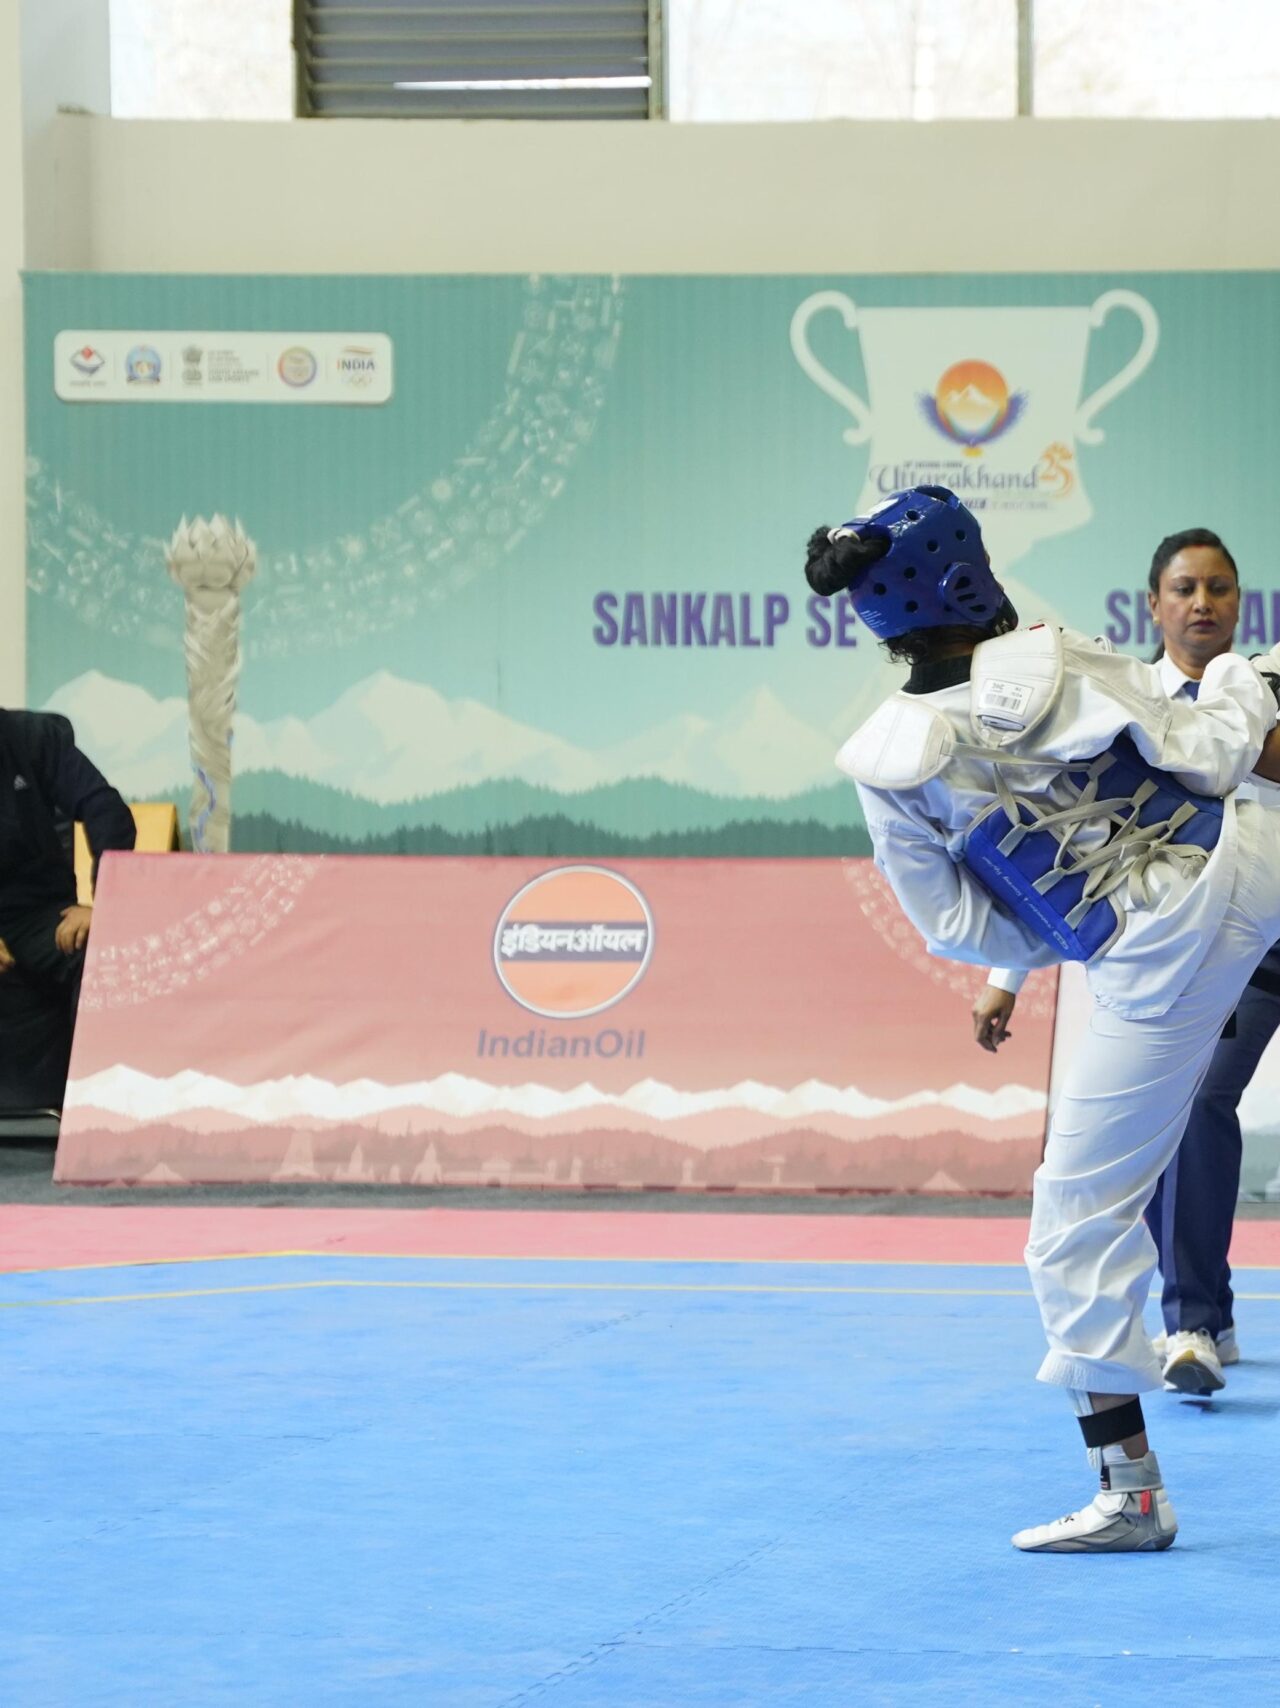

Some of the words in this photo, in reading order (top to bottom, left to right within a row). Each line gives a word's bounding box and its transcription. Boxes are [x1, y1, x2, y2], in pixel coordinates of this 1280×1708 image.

[337, 359, 376, 372] INDIA
[869, 460, 1039, 495] Uttarakhand
[592, 591, 790, 647] SANKALP
[806, 594, 857, 648] SE
[475, 1028, 647, 1059] IndianOil
